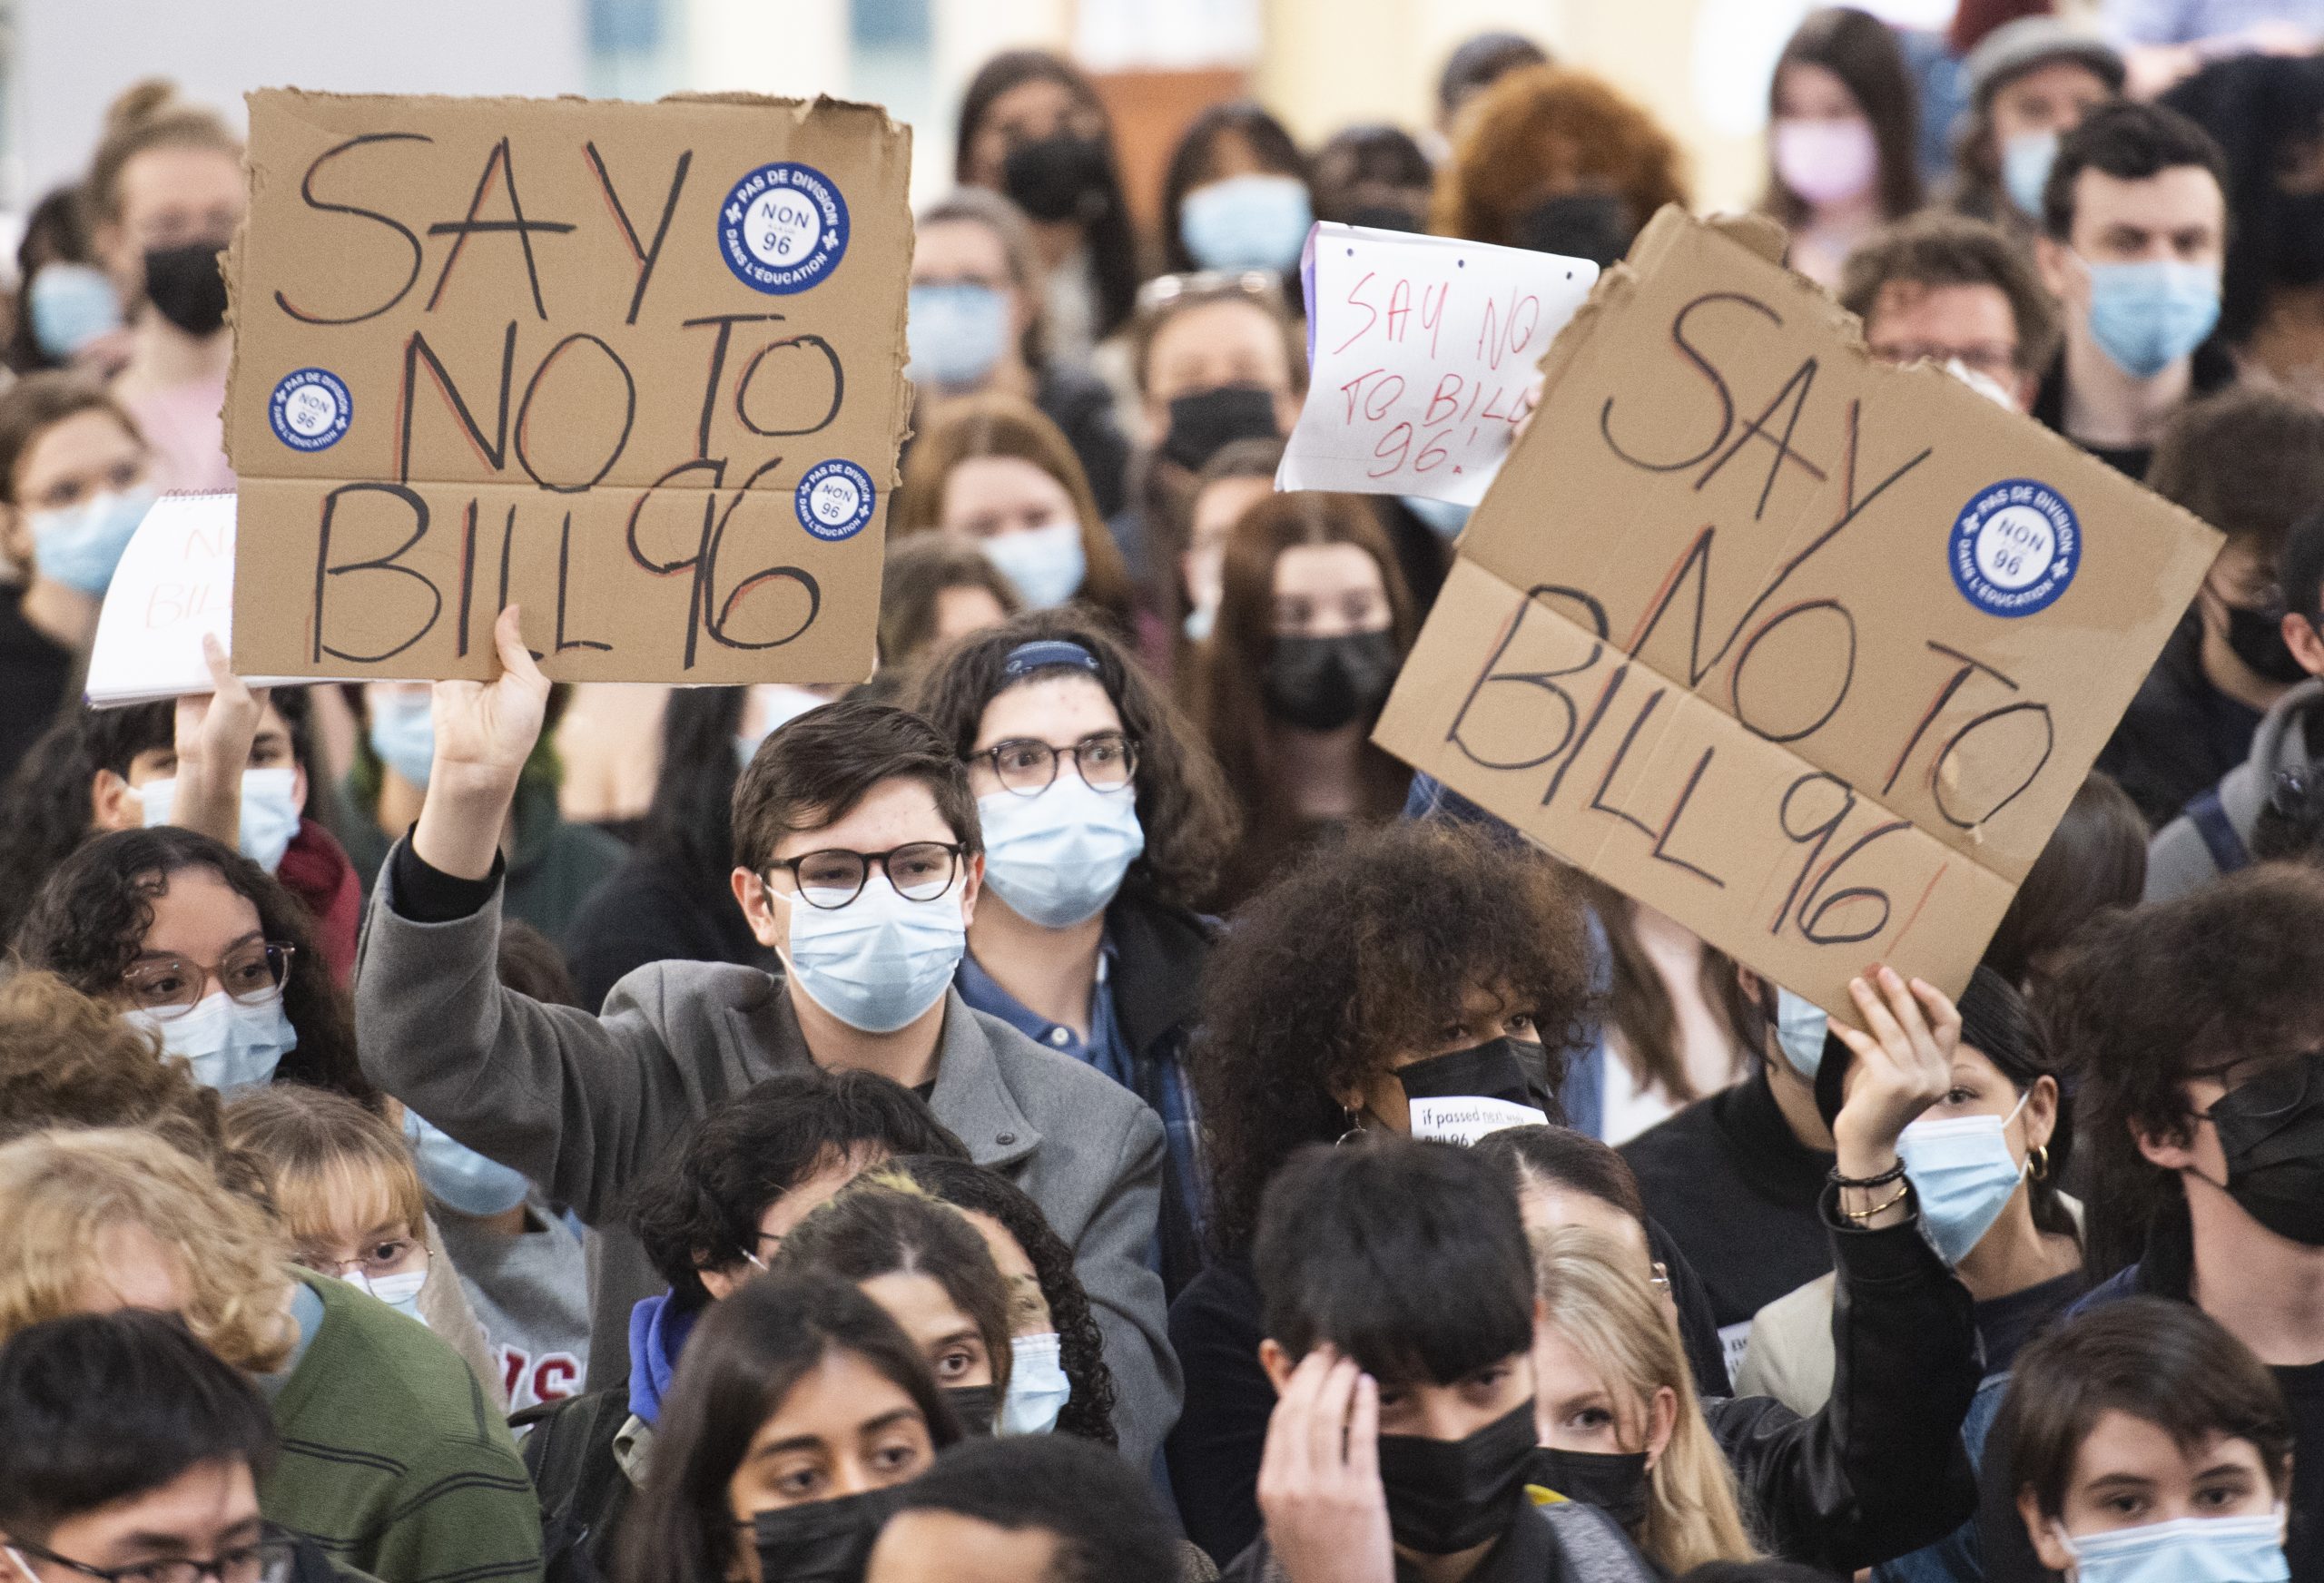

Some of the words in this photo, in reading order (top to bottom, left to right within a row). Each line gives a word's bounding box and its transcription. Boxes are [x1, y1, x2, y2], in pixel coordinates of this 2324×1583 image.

[737, 175, 765, 203] PAS
[767, 169, 788, 184] DE
[792, 171, 839, 226] DIVISION
[762, 202, 810, 229] NON
[275, 133, 693, 324] SAY
[726, 229, 747, 266] DANS
[763, 232, 792, 255] 96
[1333, 272, 1449, 359] SAY
[1476, 285, 1541, 370] NO
[299, 393, 330, 413] NON
[393, 320, 636, 494] NO
[683, 314, 844, 460] TO
[1340, 369, 1406, 425] TO
[297, 412, 316, 428] 96
[1601, 292, 1933, 568] SAY
[1367, 421, 1478, 479] 96!
[809, 467, 828, 483] PAS
[829, 464, 843, 473] DE
[844, 466, 871, 502] DIVISION
[822, 483, 853, 502] NON
[799, 498, 812, 522] DANS
[822, 503, 840, 518] 96
[1976, 488, 2009, 516] PAS
[2010, 486, 2034, 503] DE
[2034, 490, 2073, 556] DIVISION
[1997, 517, 2044, 552] NON
[306, 483, 614, 664] BILL
[625, 457, 821, 670] 96
[1958, 538, 1975, 580] DANS
[1994, 549, 2023, 576] 96
[1624, 524, 1856, 742] NO
[1883, 639, 2053, 830] TO
[1445, 584, 1726, 889] BILL
[1423, 1108, 1432, 1126] if
[1436, 1106, 1480, 1128] passed
